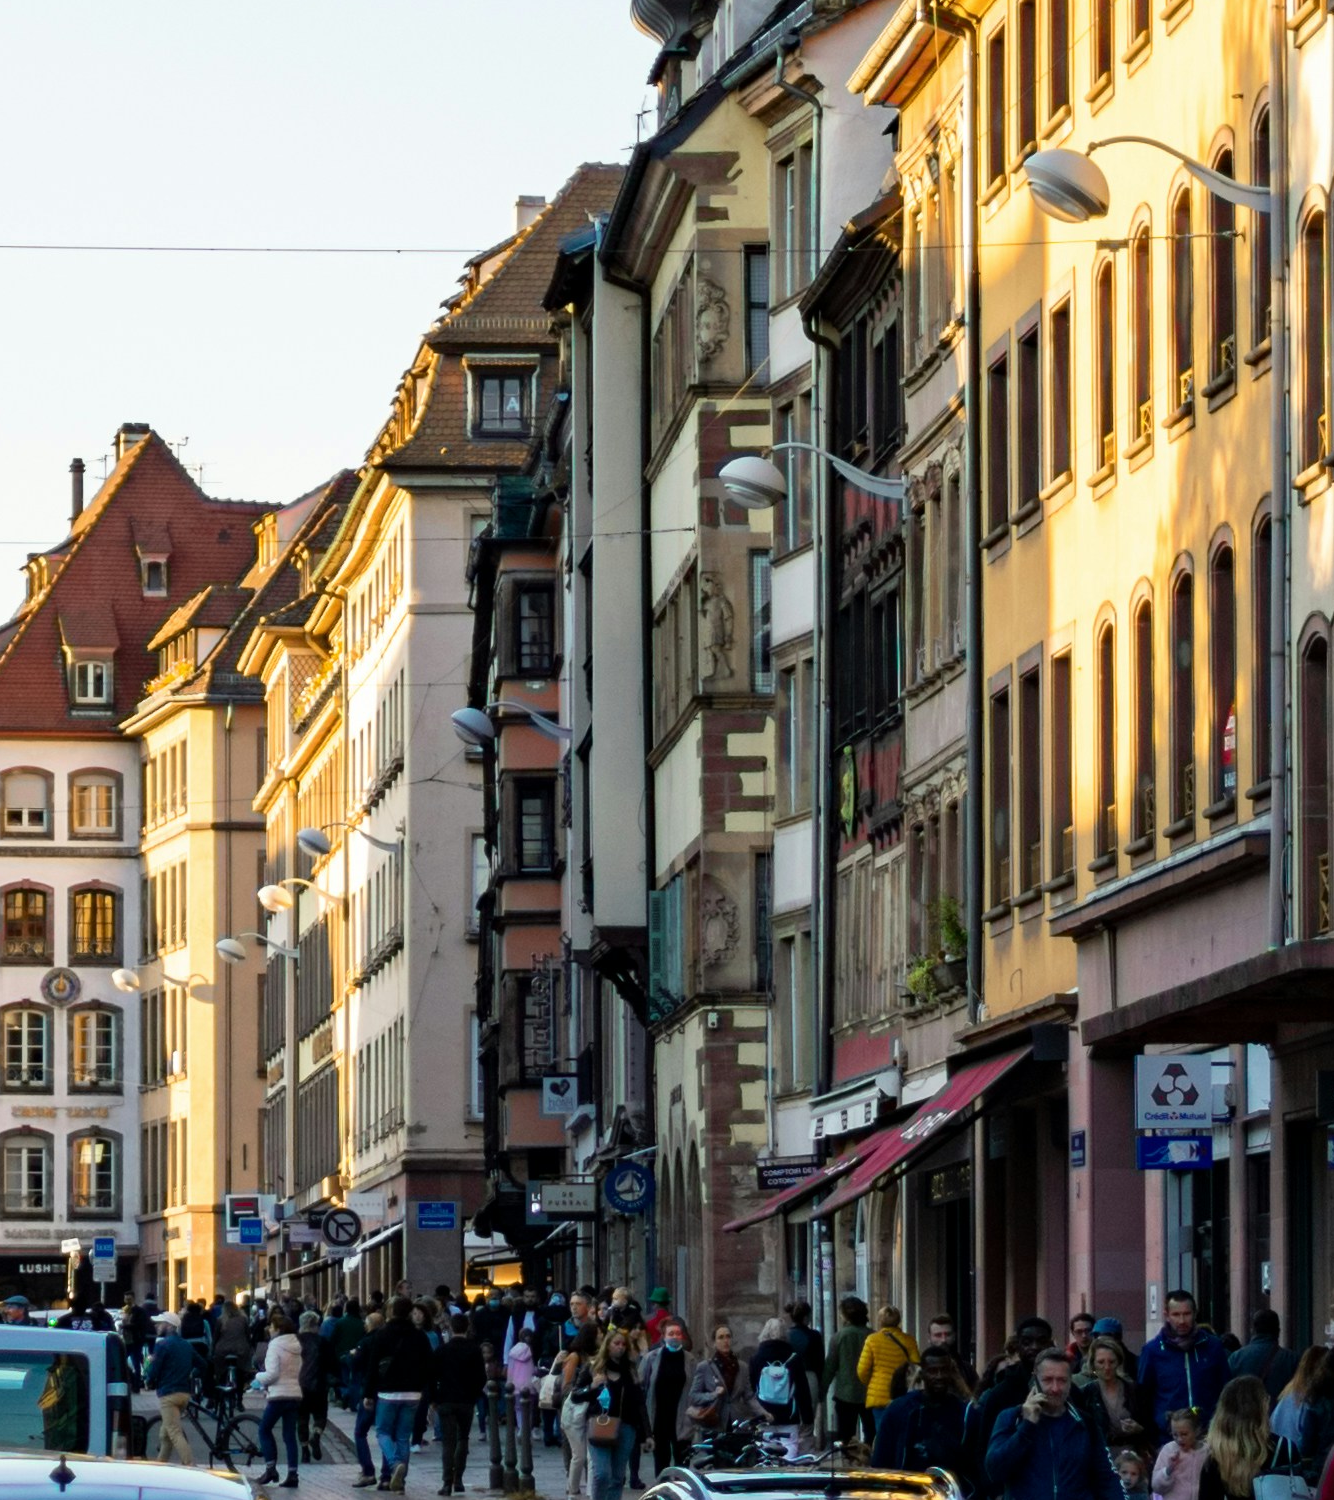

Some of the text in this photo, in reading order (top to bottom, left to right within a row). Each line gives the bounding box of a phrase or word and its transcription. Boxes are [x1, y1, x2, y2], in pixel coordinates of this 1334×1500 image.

[1144, 1111, 1207, 1121] Crédit Mutuel
[19, 1263, 51, 1274] LUSH
